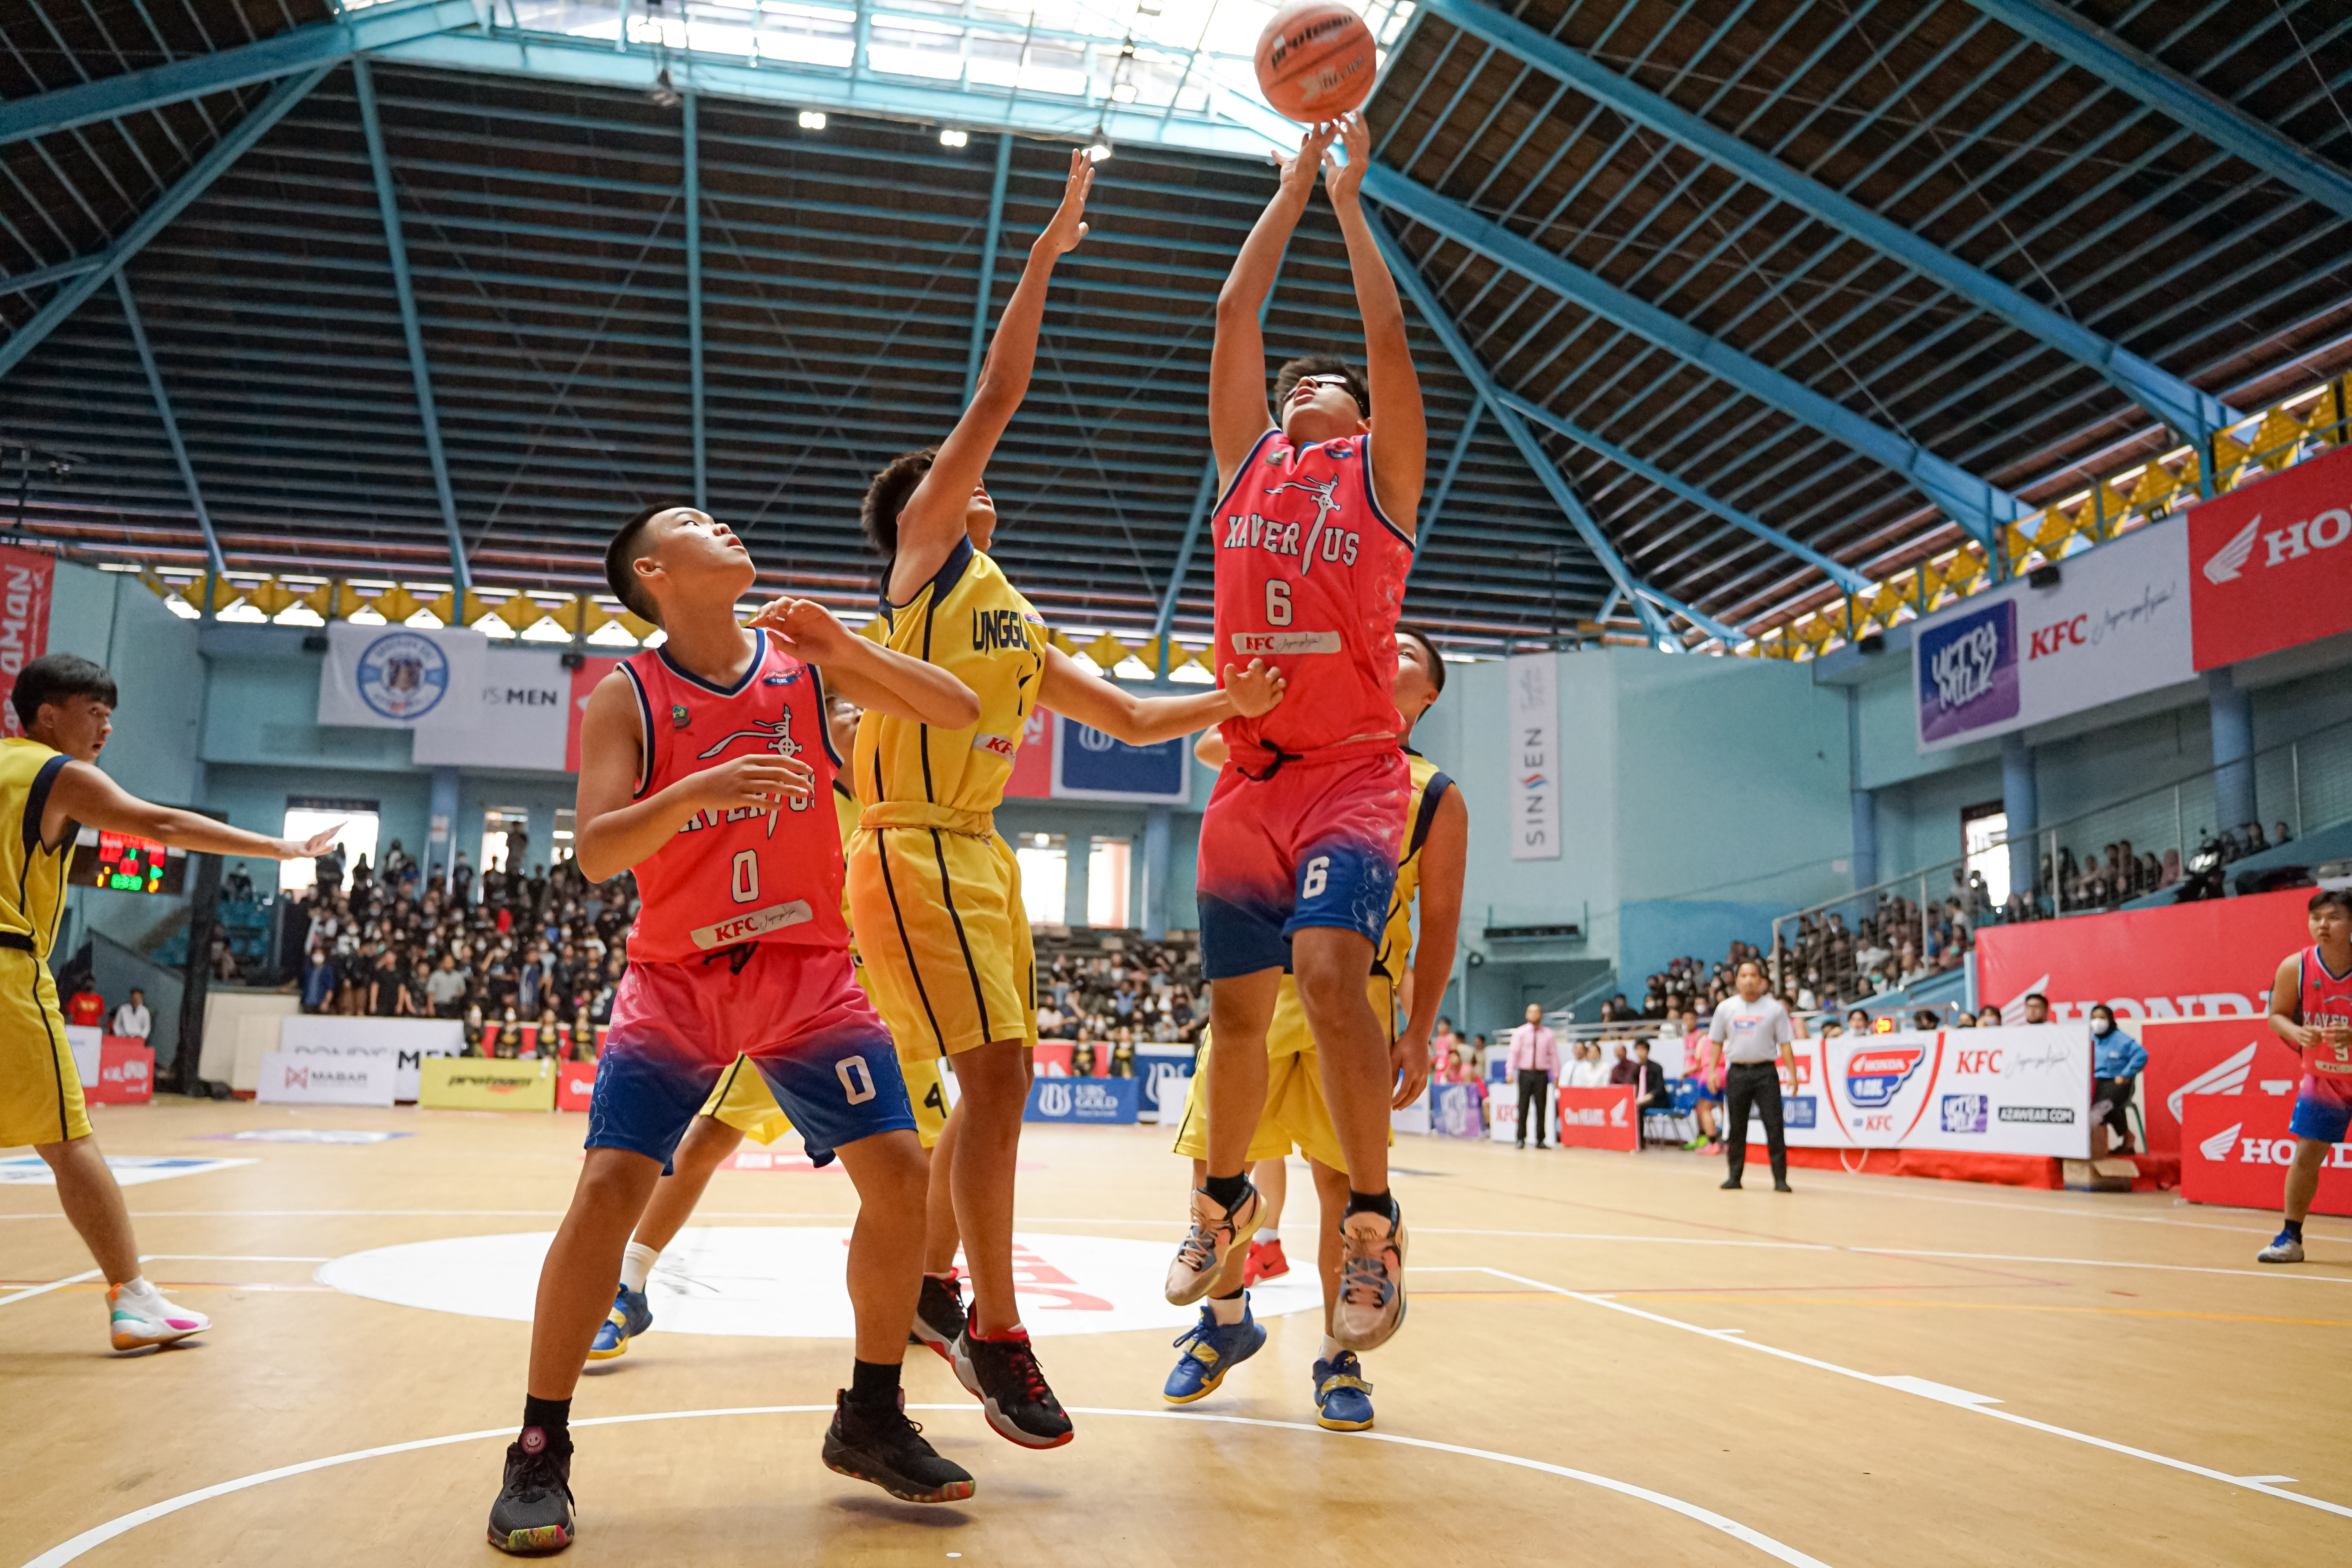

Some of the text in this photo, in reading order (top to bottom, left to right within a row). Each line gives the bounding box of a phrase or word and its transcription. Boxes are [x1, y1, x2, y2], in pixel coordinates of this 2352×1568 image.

[1265, 579, 1292, 627] 6
[2028, 614, 2087, 660] KFC
[507, 686, 557, 706] MEN
[731, 849, 759, 903] 0
[1302, 856, 1330, 899] 6
[715, 917, 758, 942] KFC
[835, 1055, 876, 1105] 0
[1956, 1049, 2002, 1074] KFC
[924, 1082, 947, 1119] 4
[1866, 1115, 1893, 1131] KFC
